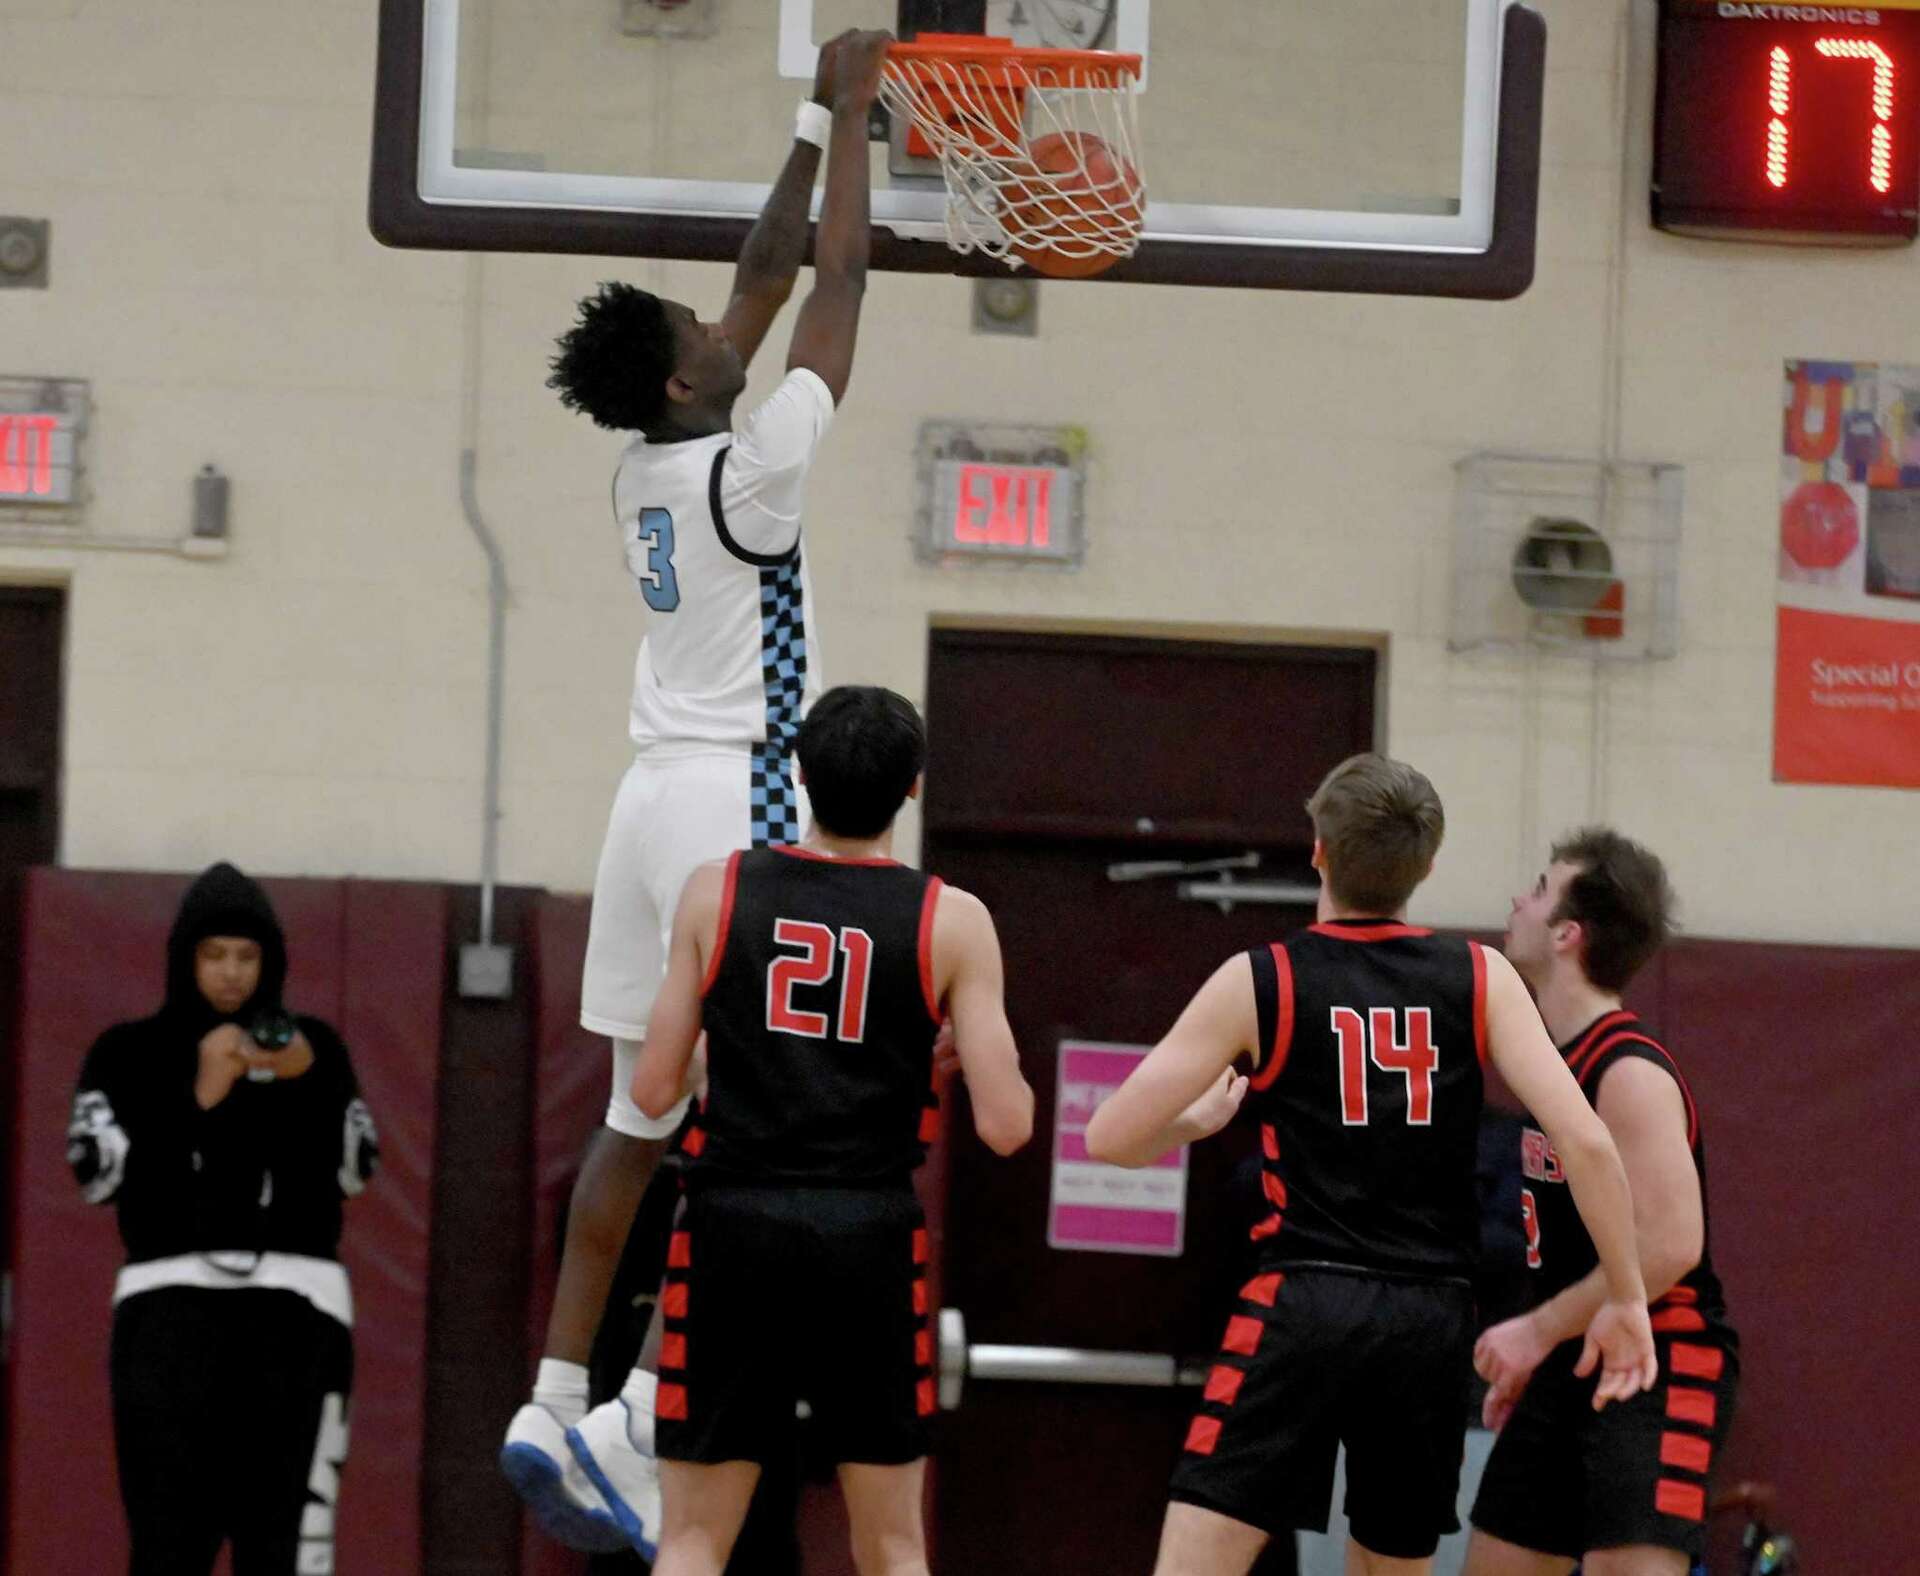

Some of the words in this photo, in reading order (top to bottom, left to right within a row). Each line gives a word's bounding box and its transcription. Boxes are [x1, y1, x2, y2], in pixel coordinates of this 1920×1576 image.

[1717, 3, 1880, 25] DAKTRONICS
[1766, 37, 1894, 192] 17
[954, 463, 1056, 546] EXIT
[638, 507, 681, 612] 3
[1810, 658, 1898, 688] Special
[766, 917, 873, 1043] 21
[1330, 1006, 1439, 1126] 14
